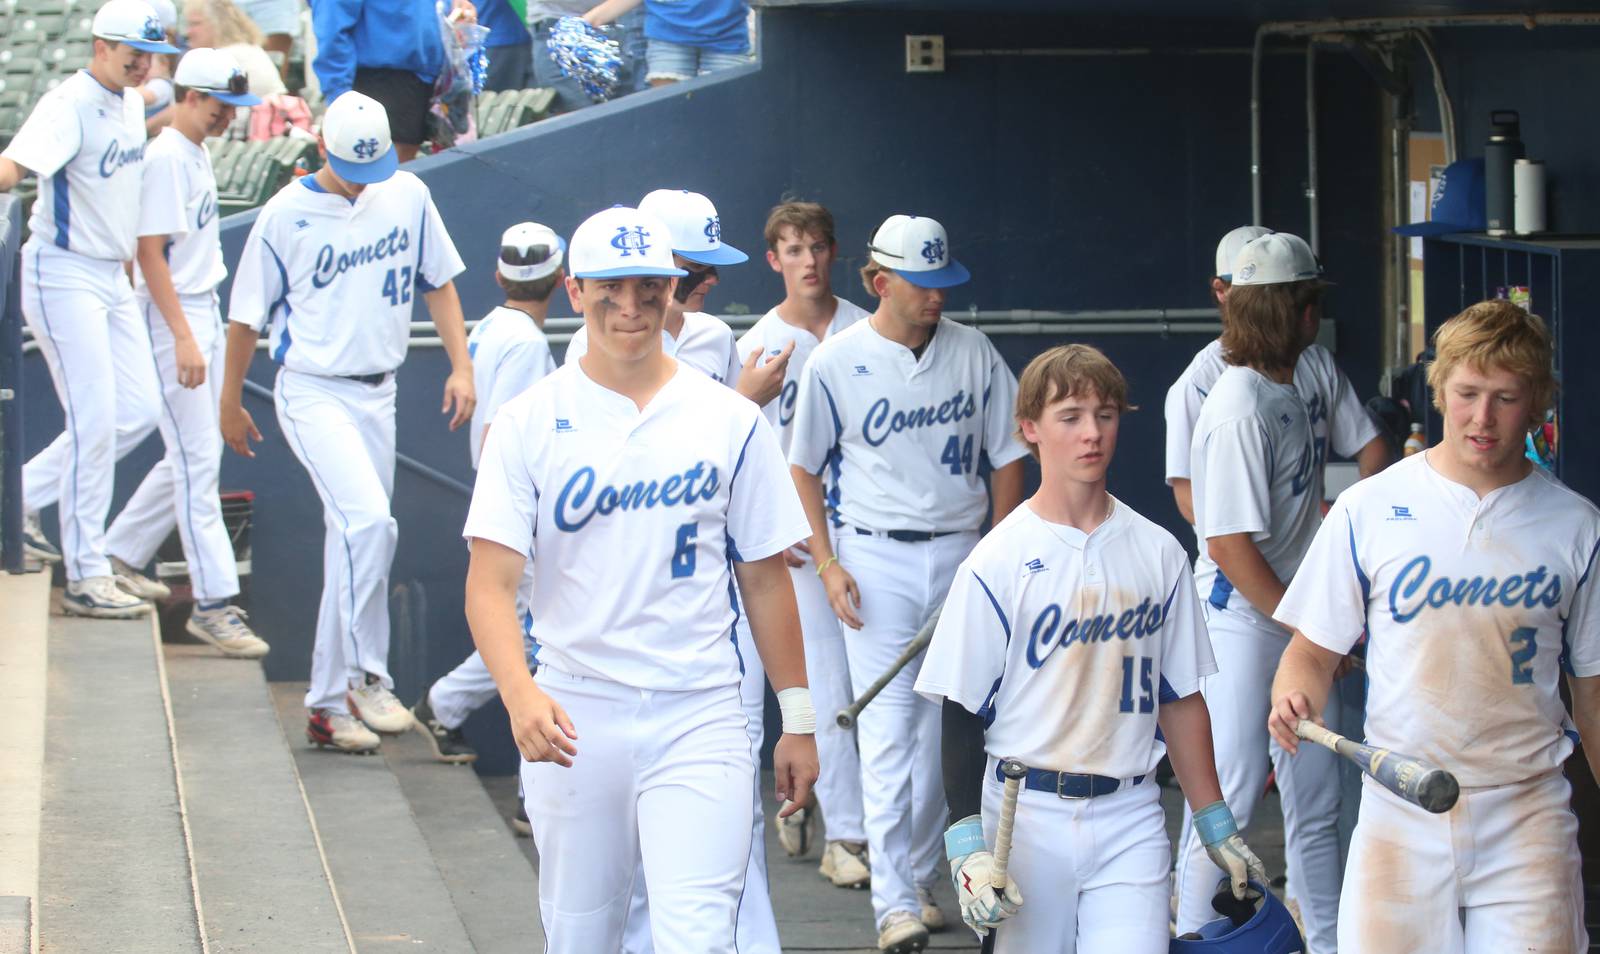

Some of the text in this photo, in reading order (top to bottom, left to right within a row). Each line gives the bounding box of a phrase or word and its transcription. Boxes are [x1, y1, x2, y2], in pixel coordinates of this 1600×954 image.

[314, 226, 408, 288] Comets
[383, 266, 412, 305] 42
[862, 391, 976, 446] Comets
[941, 435, 972, 474] 44
[554, 461, 721, 532] Comets
[671, 522, 698, 579] 6
[1389, 554, 1562, 623] Comets
[1026, 597, 1164, 669] Comets
[1510, 627, 1537, 685] 2
[1119, 656, 1154, 714] 15
